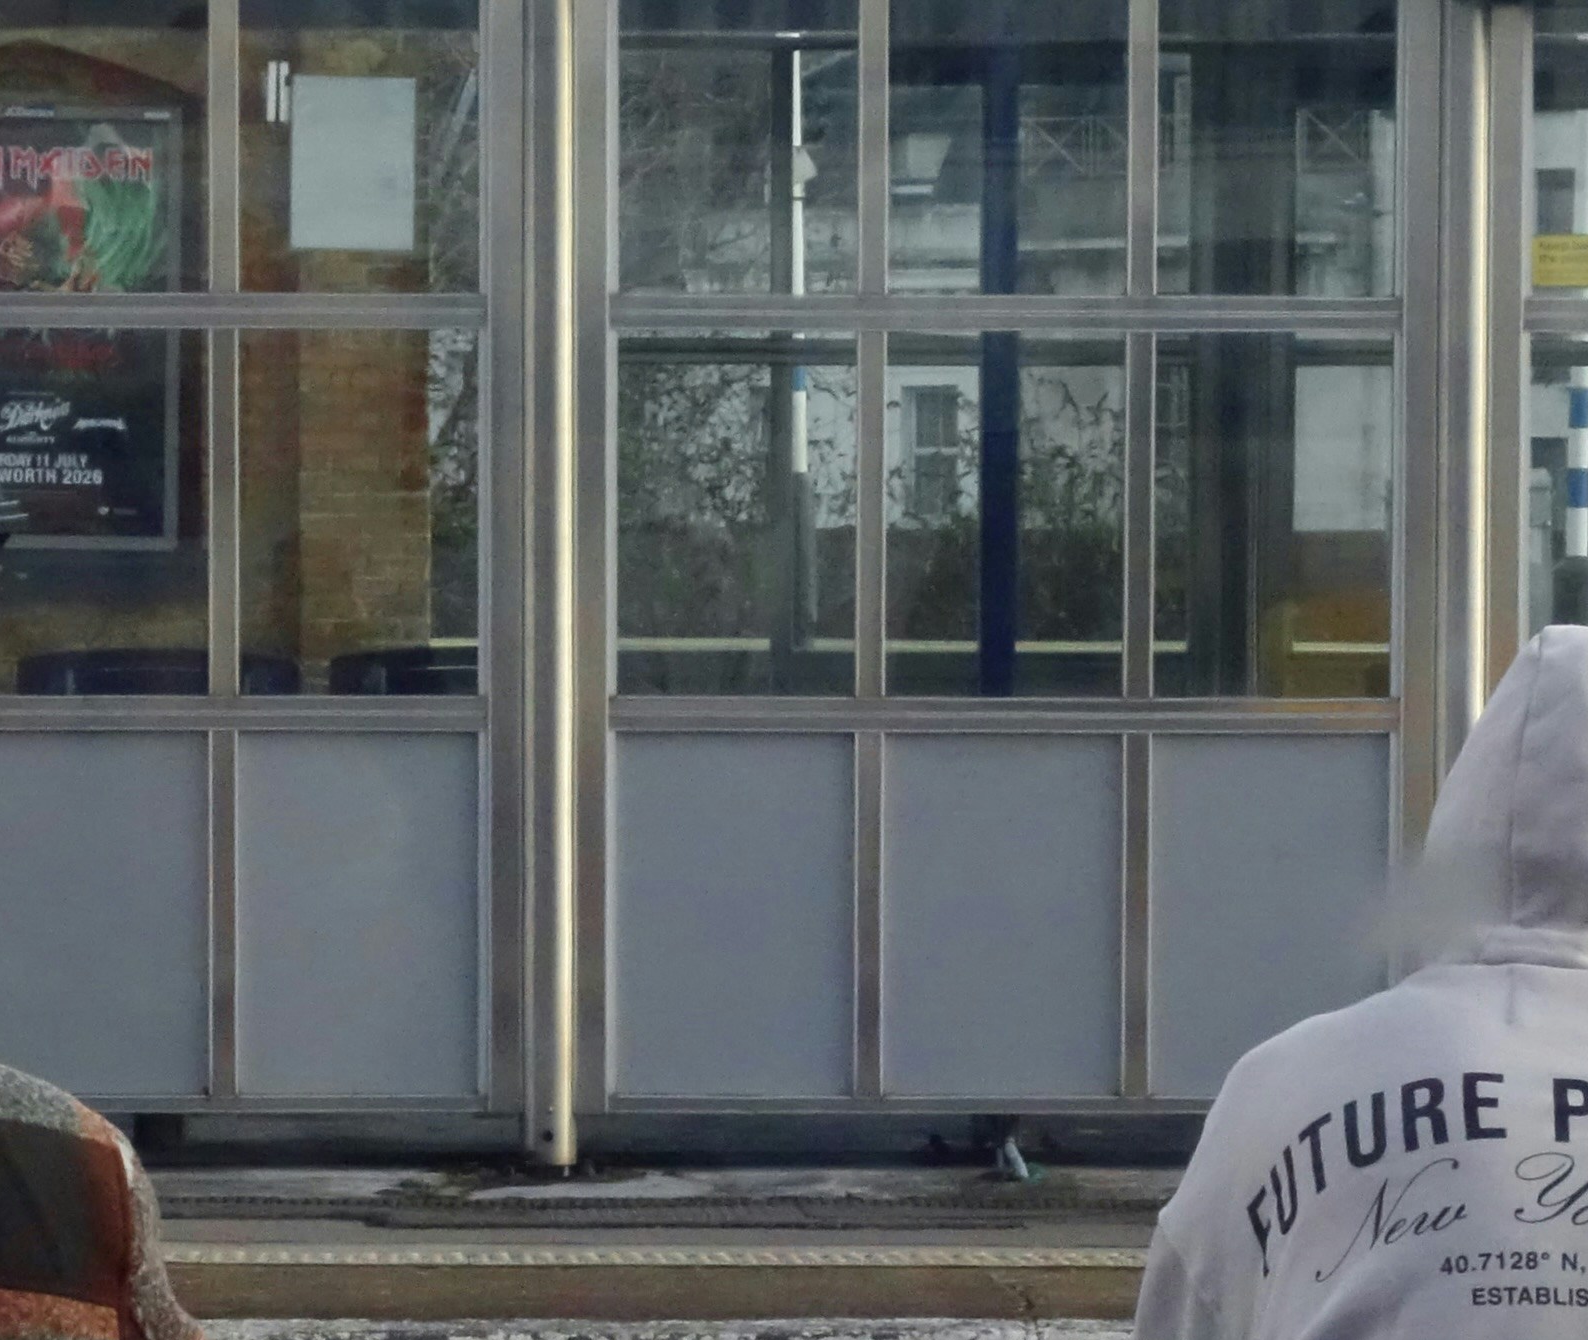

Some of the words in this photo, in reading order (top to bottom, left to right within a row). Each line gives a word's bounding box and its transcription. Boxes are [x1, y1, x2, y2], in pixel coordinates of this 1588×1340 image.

[61, 469, 104, 485] 2026
[1246, 1071, 1508, 1279] FUTURE
[1315, 1157, 1468, 1283] New
[1439, 1251, 1551, 1276] 40.7128°
[1561, 1252, 1587, 1275] N,
